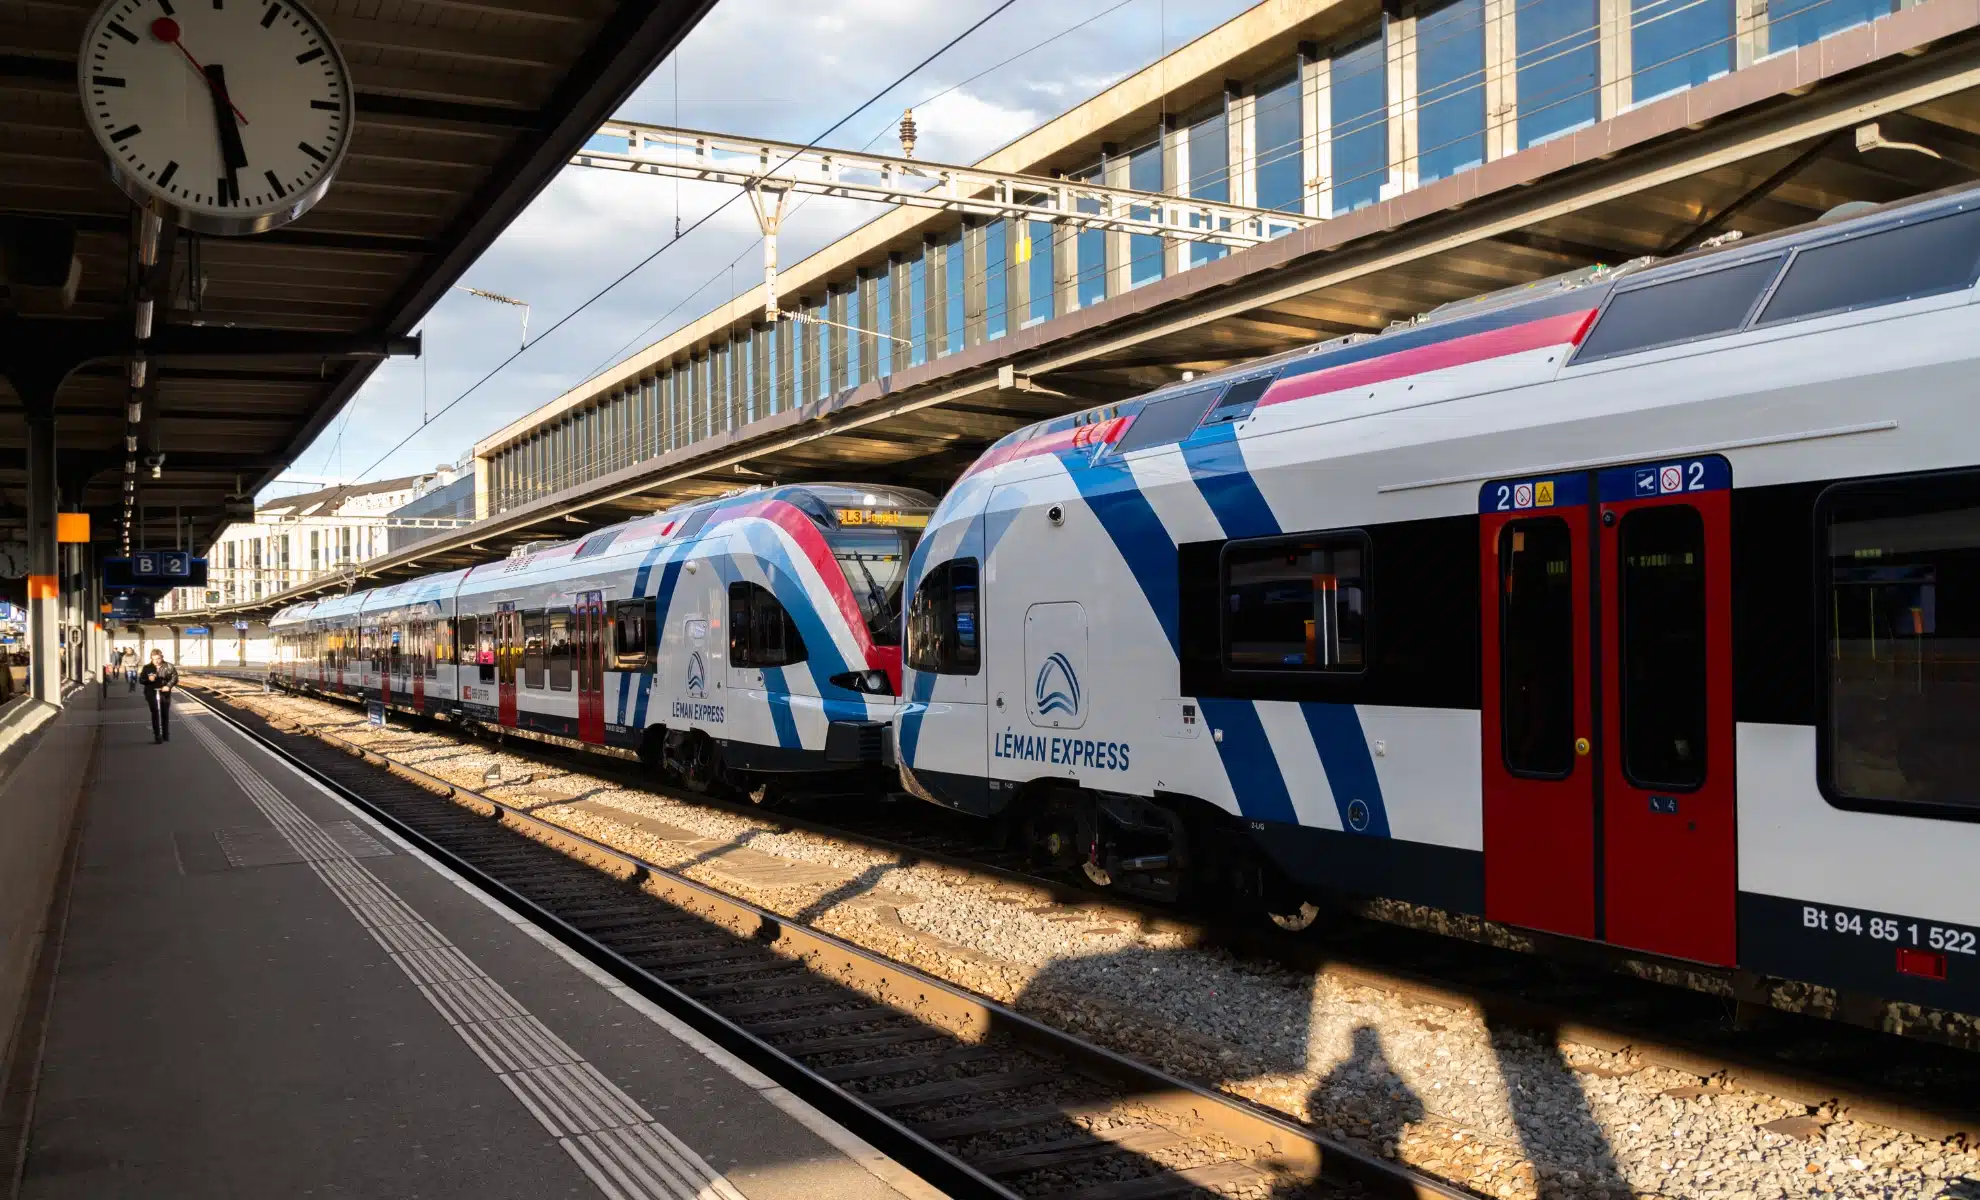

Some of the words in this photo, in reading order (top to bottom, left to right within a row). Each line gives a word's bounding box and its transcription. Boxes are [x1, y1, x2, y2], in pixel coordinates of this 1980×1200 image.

[1688, 461, 1705, 490] 2
[1496, 485, 1510, 511] 2
[140, 558, 153, 572] B
[169, 558, 181, 572] 2
[672, 697, 694, 720] LÉMAN
[694, 703, 724, 723] EXPRESS
[994, 726, 1047, 763] LÉMAN
[1050, 737, 1130, 771] EXPRESS
[1803, 906, 1828, 930] Bt
[1834, 911, 1863, 936] 94
[1869, 917, 1899, 942] 85
[1907, 923, 1918, 945] 1
[1928, 926, 1976, 955] 522
